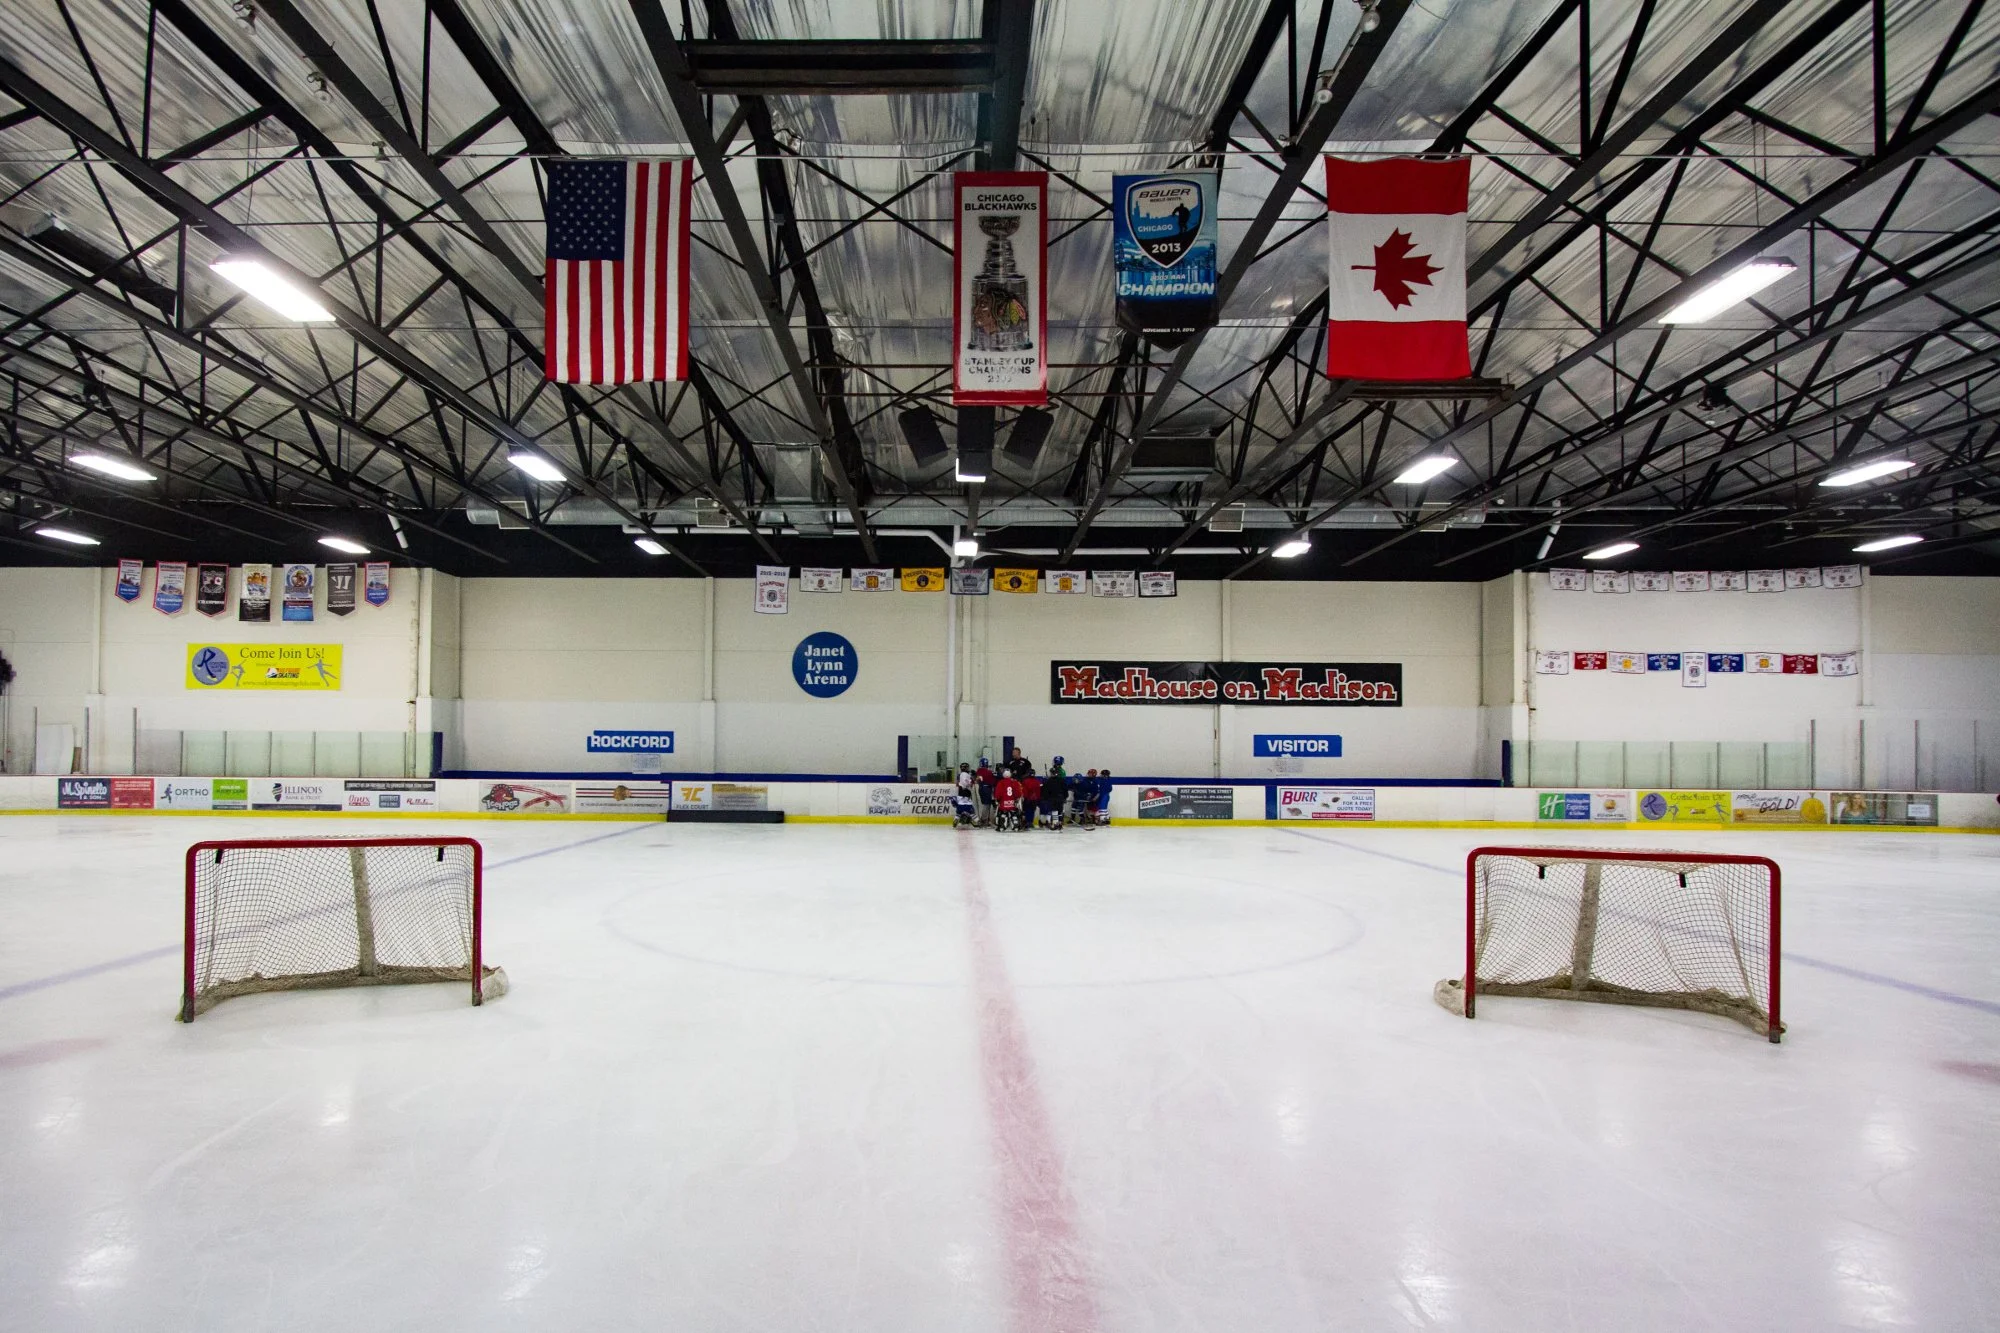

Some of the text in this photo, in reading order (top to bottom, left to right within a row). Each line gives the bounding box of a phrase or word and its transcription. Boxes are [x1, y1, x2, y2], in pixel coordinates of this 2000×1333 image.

[977, 194, 1024, 202] CHICAGO
[964, 203, 1038, 211] BLACKHAWKS
[1138, 224, 1174, 232] CHICAGO
[1152, 243, 1182, 253] 2013
[1120, 282, 1215, 296] CHAMPION
[1014, 358, 1036, 366] CUP
[968, 366, 1032, 374] CHAPNS
[240, 647, 326, 660] Come Join Us!
[804, 644, 845, 657] Janet
[807, 658, 844, 674] Lynn
[802, 672, 848, 685] Arena
[1058, 666, 1398, 701] Madhouse on Madison
[591, 735, 671, 748] ROCKFORD
[1267, 739, 1329, 752] VISITOR
[175, 788, 209, 796] ORTHO
[284, 786, 323, 794] ILLINOIS
[1006, 786, 1013, 797] 8
[904, 795, 951, 805] ROCKFOR
[1282, 791, 1318, 805] BURR
[911, 805, 950, 814] ICEMEN
[1760, 795, 1800, 813] GOLD!
